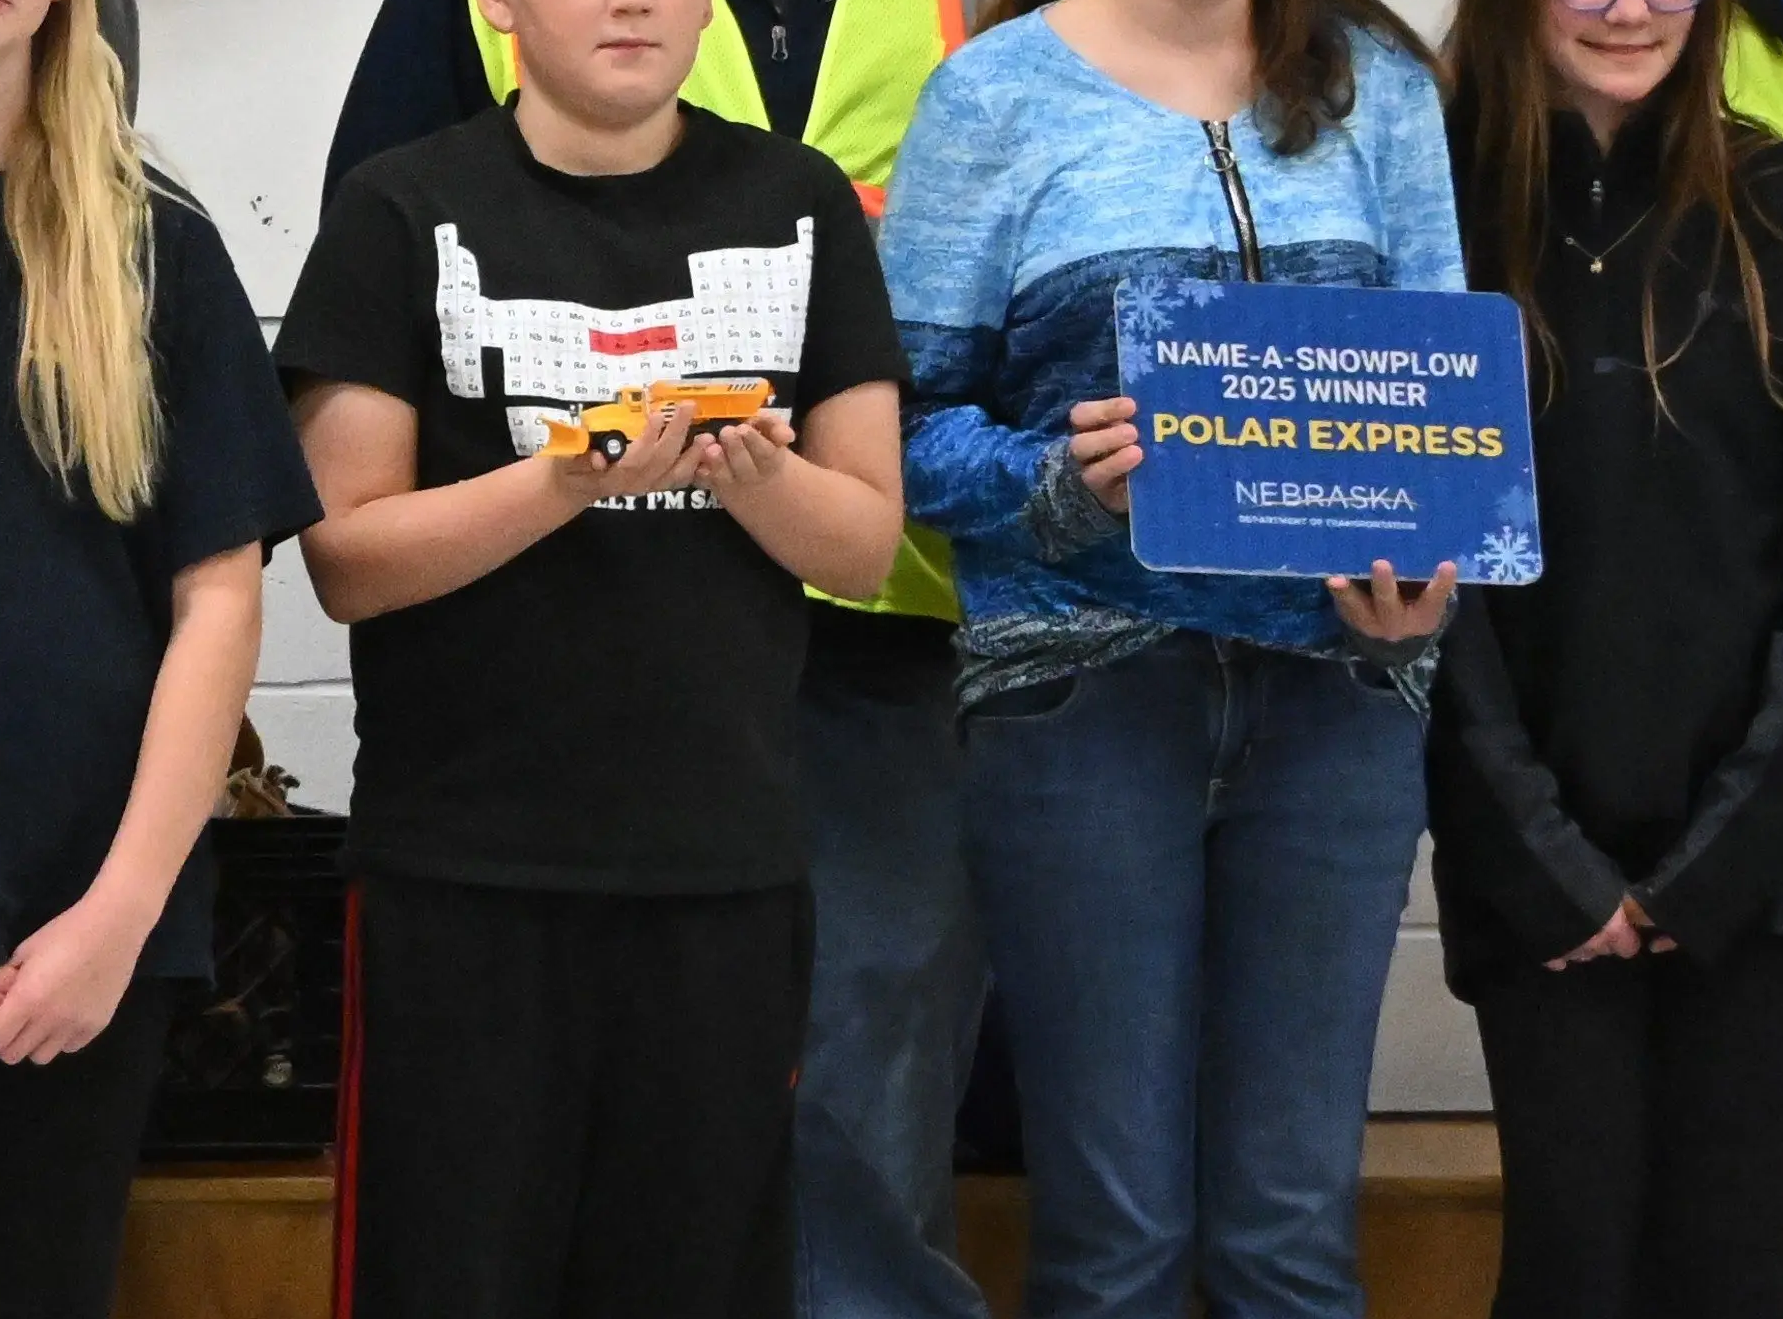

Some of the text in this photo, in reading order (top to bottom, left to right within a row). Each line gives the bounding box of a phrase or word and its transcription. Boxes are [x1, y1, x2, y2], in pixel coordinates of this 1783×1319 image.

[1156, 340, 1479, 378] NAME-A-SNOWPLOW
[1221, 374, 1426, 407] 2025 WINNER
[1152, 413, 1504, 457] POLAR EXPRESS
[646, 490, 685, 510] I'M
[690, 489, 722, 510] SA
[1236, 480, 1414, 511] NEBRASKA
